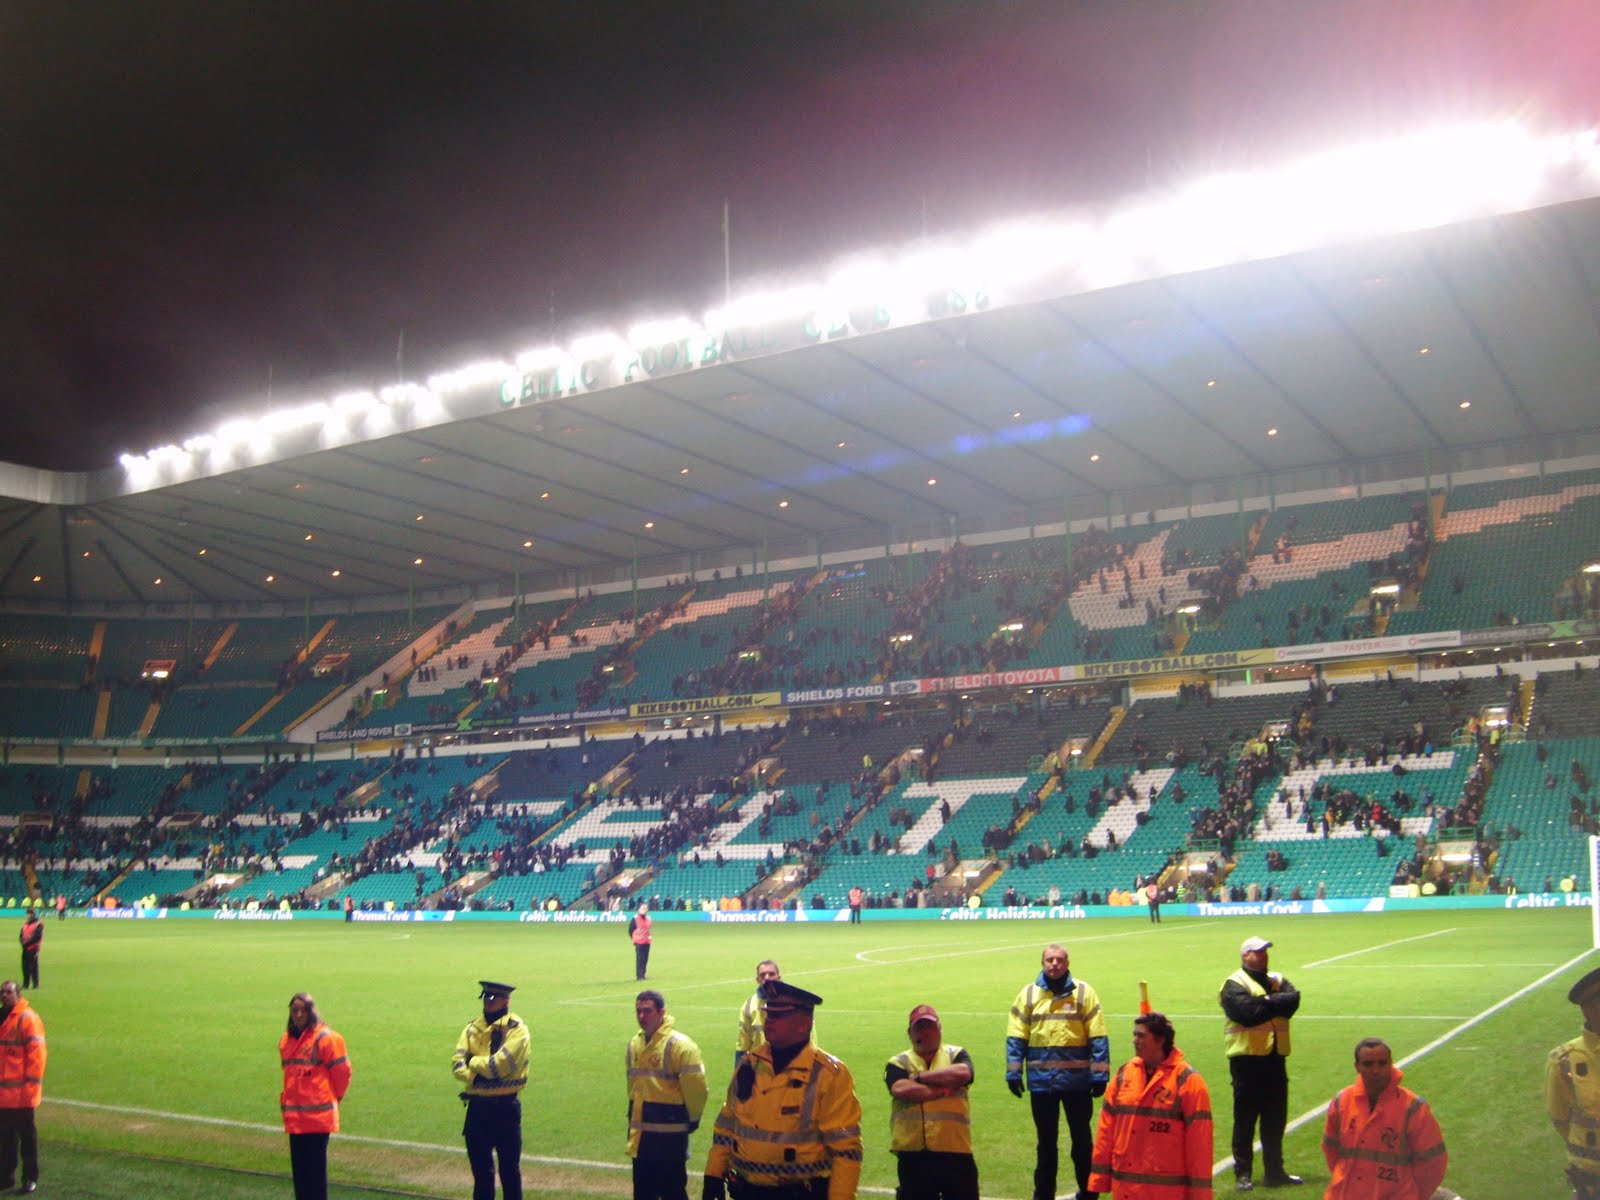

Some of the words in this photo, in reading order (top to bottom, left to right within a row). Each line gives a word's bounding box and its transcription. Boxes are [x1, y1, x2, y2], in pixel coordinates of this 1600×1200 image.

[499, 358, 601, 408] CELTIC
[1084, 652, 1238, 677] NIKEFOOTBALL.COM
[997, 668, 1056, 686] TOYOTA
[786, 689, 843, 702] SHIELDS
[847, 684, 884, 699] FORD
[637, 695, 753, 714] NIKEFOOTBALL.COM
[1504, 892, 1560, 909] Celtic
[520, 910, 552, 923] Celtic
[553, 910, 598, 923] Holiday
[600, 910, 627, 922] Club
[709, 910, 756, 922] Thomas
[986, 905, 1046, 920] Holiday
[1049, 904, 1086, 919] Club
[1198, 903, 1262, 916] Thomas
[1149, 1120, 1172, 1134] 282
